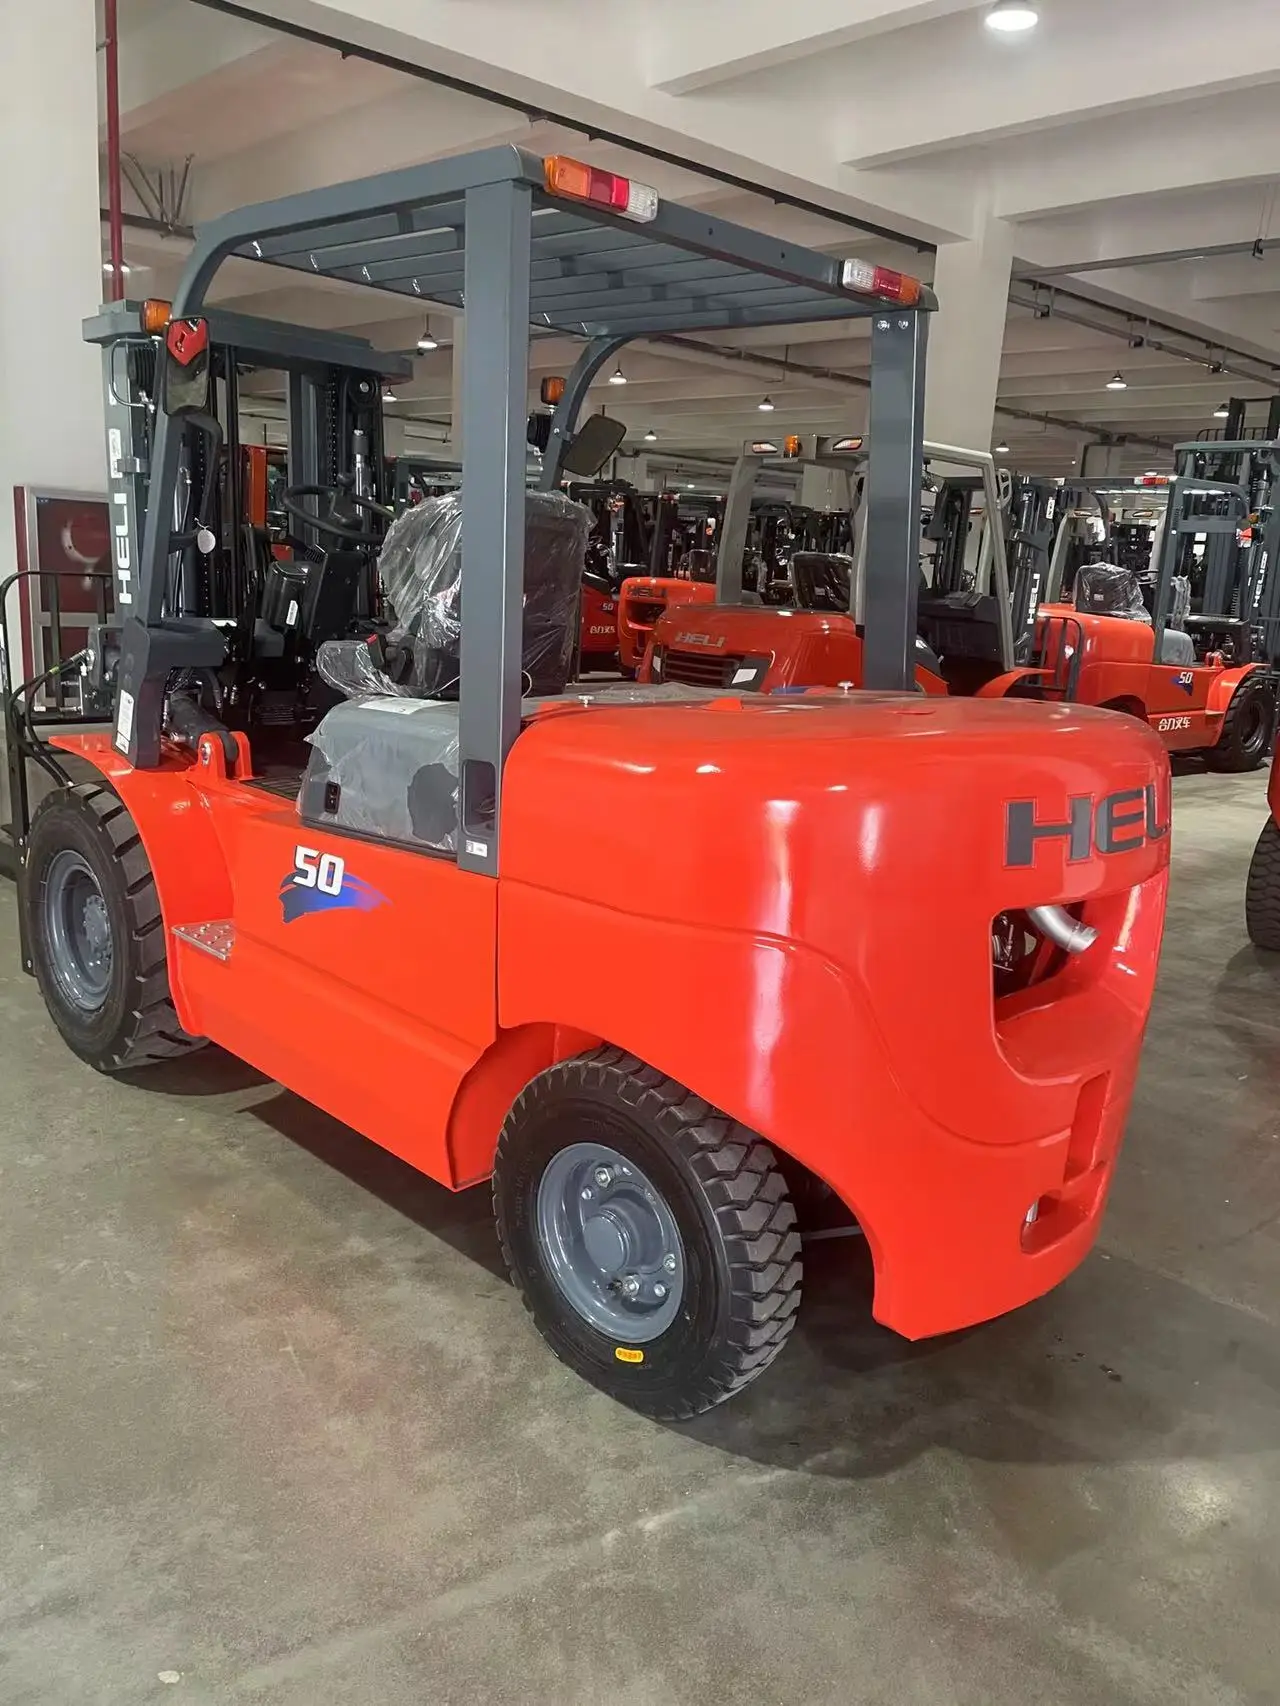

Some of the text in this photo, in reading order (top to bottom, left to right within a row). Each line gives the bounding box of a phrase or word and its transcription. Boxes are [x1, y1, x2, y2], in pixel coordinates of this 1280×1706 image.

[113, 493, 133, 604] HELI
[1026, 573, 1041, 625] HELI
[1251, 567, 1266, 608] HELI
[601, 602, 614, 611] 50
[674, 631, 726, 648] HELI
[1178, 671, 1194, 684] 50
[1158, 716, 1192, 732] 合力叉车
[292, 845, 345, 897] 50
